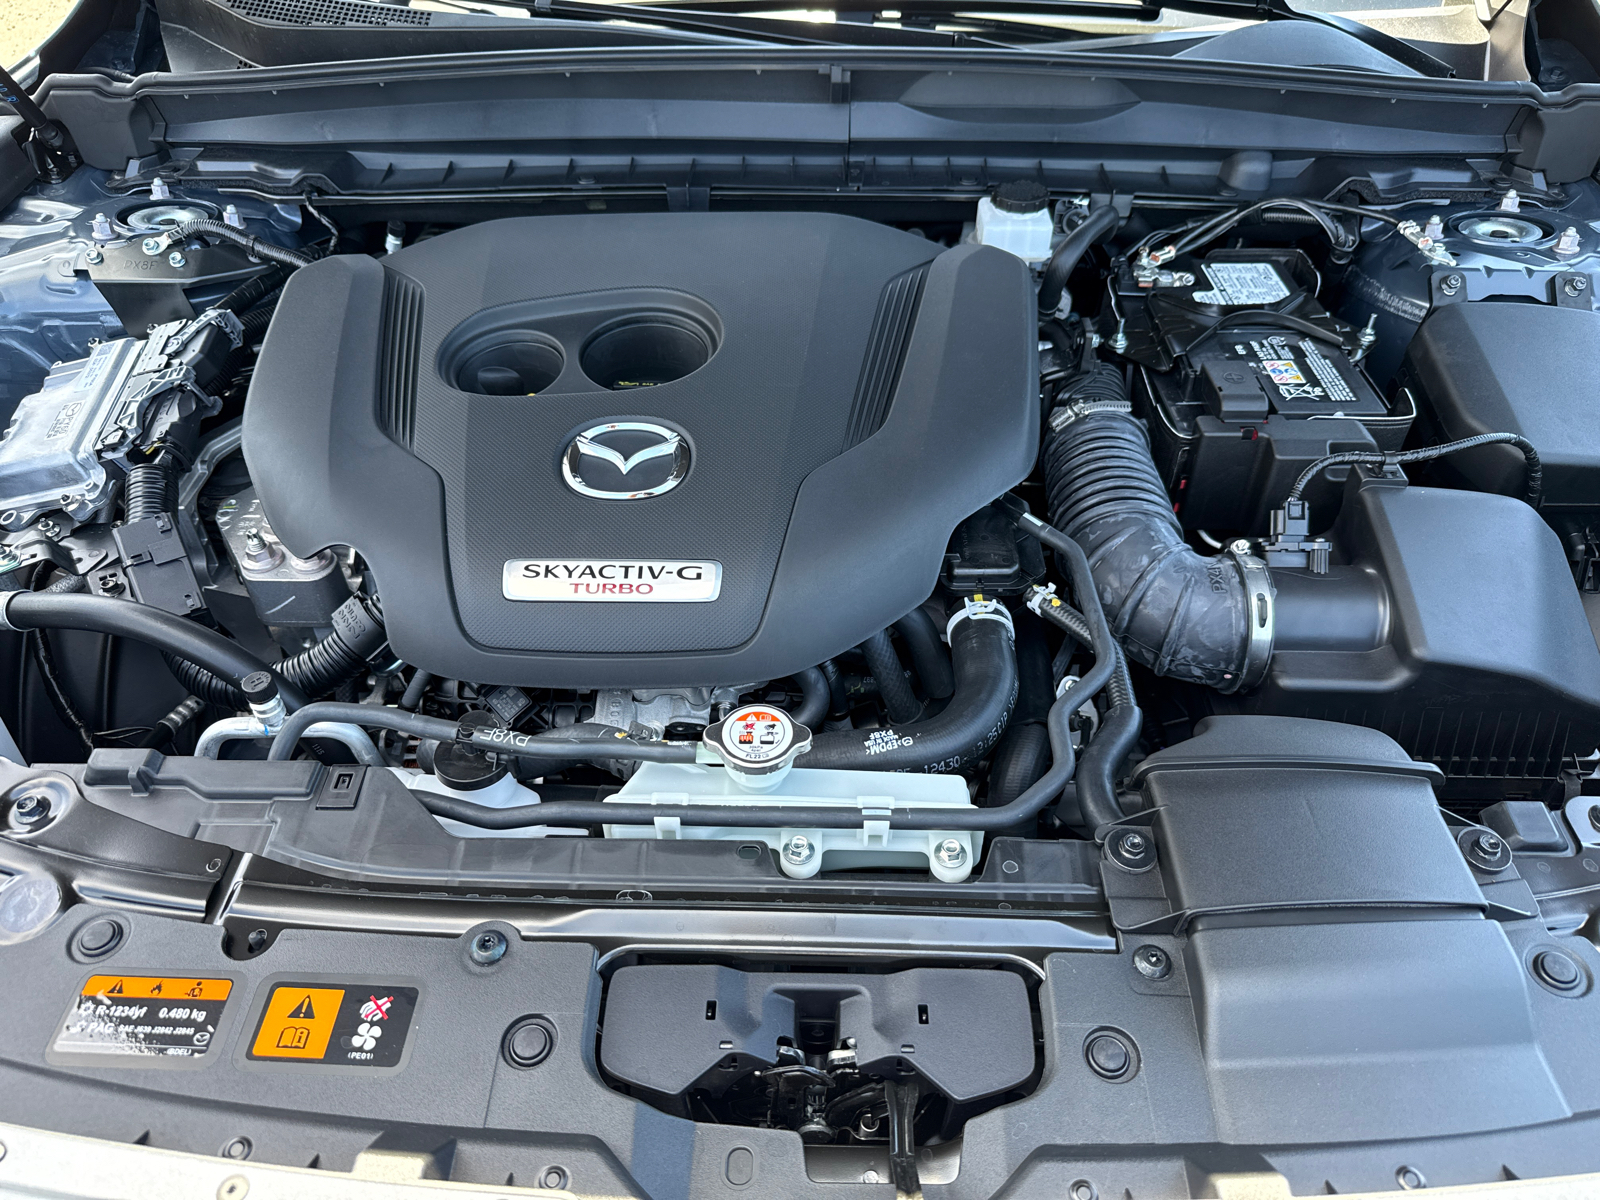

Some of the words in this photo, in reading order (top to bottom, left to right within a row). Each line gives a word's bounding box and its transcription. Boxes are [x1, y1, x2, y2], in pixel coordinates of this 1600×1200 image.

[522, 564, 703, 581] SKYACTIV-G
[569, 583, 654, 595] TURBO
[479, 727, 532, 747] PX8F
[868, 729, 894, 741] PX8F
[95, 1004, 148, 1020] R-1234yf
[158, 1007, 191, 1019] 0.480
[190, 1008, 207, 1022] kg
[86, 1022, 115, 1034] PAG
[119, 1024, 135, 1033] SAE
[347, 1051, 374, 1060] (PE01)
